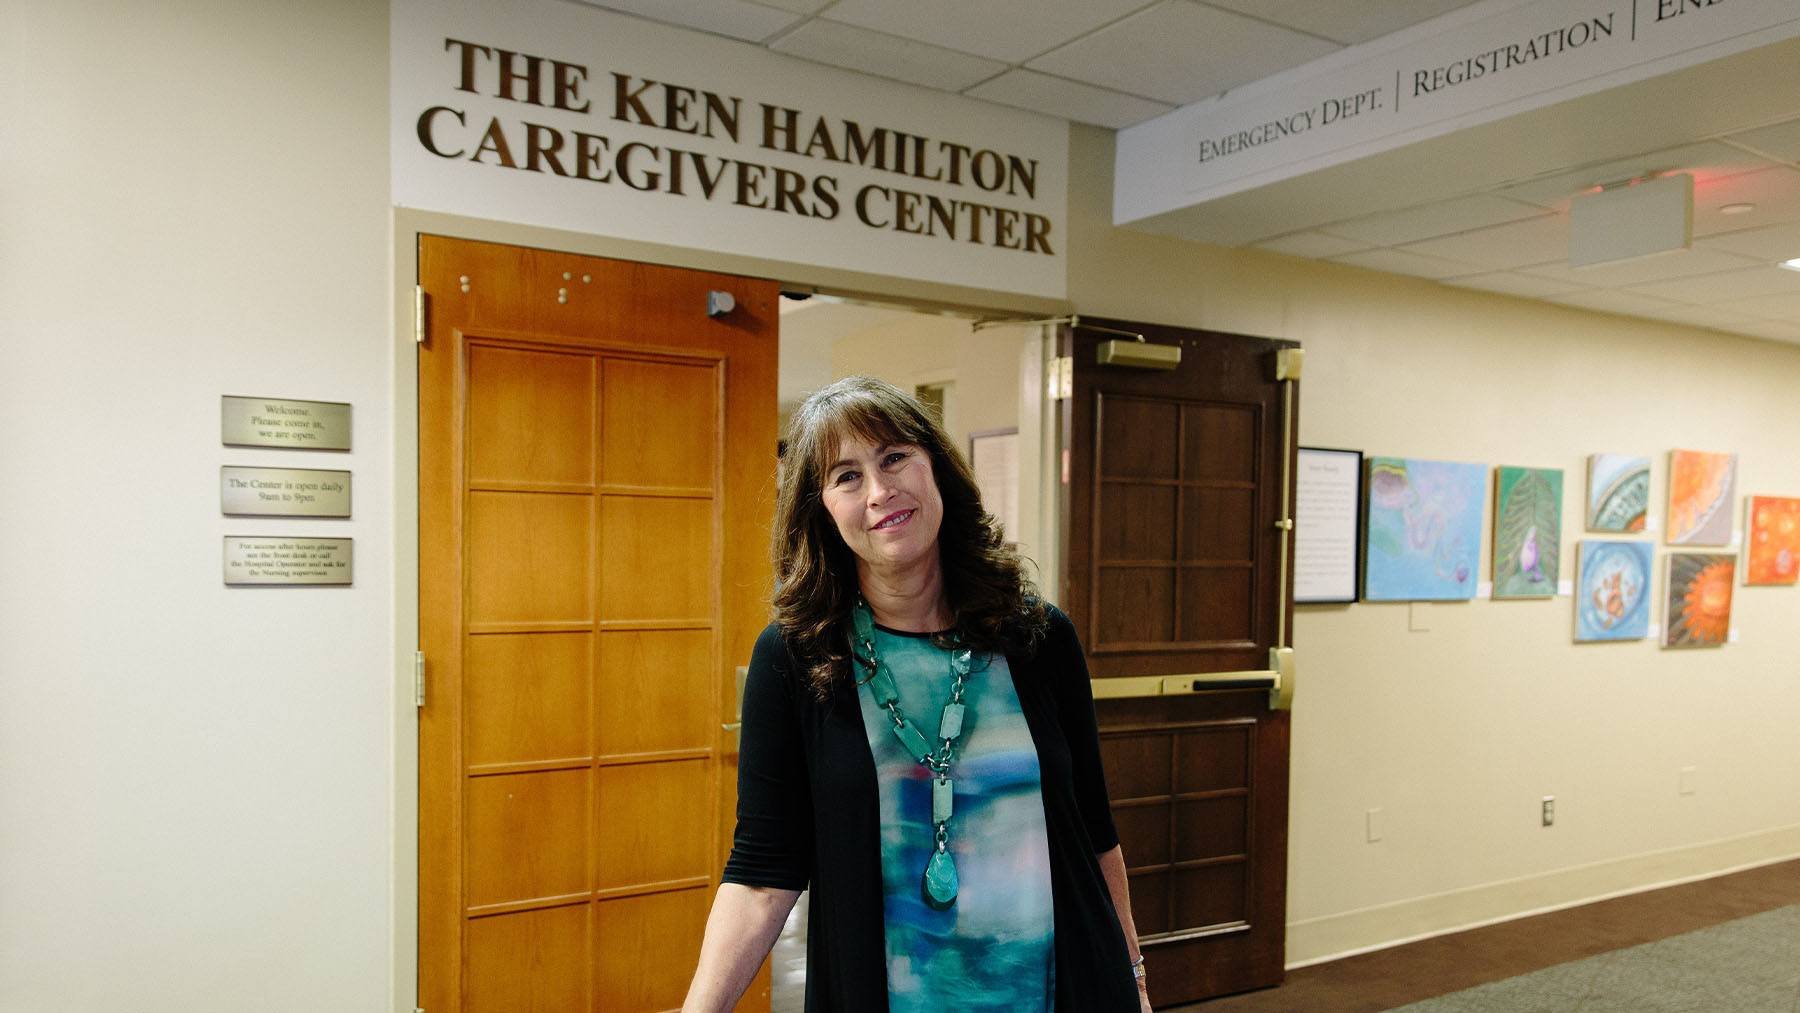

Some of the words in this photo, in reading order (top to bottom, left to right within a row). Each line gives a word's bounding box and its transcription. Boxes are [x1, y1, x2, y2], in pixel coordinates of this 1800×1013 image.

[1198, 108, 1316, 163] EMERGENCY
[1321, 87, 1382, 126] DEPT.
[1412, 11, 1615, 97] REGISTRATION
[445, 38, 590, 114] THE
[610, 72, 742, 144] KEN
[759, 103, 1039, 200] HAMILTON
[416, 106, 840, 220] CAREGIVERS
[855, 184, 1055, 255] CENTER
[250, 416, 281, 426] Please
[284, 419, 310, 428] come
[258, 430, 273, 438] we
[229, 478, 247, 489] The
[250, 479, 282, 489] Center
[284, 480, 293, 490] is
[295, 481, 318, 491] open
[321, 481, 344, 493] daily
[258, 491, 280, 501] 9am
[282, 492, 292, 501] to
